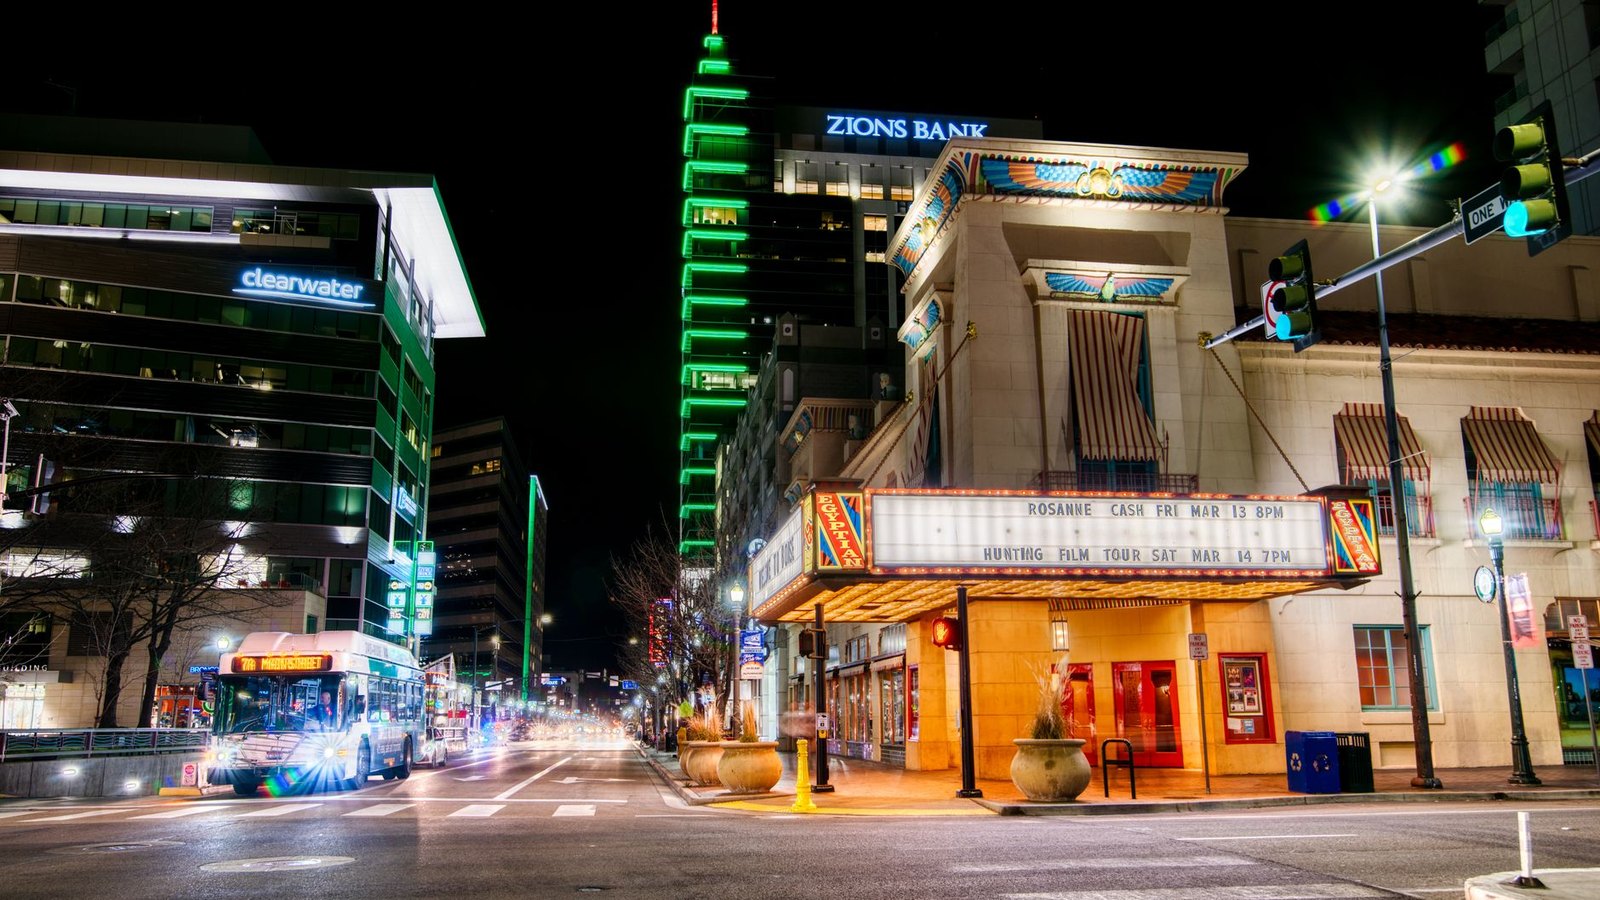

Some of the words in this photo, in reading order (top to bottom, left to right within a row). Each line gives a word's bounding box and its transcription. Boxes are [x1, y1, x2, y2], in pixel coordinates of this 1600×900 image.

[827, 115, 907, 139] ZIONS
[913, 120, 988, 141] BANK
[1472, 203, 1495, 226] ONE
[241, 267, 363, 300] clearwater
[1028, 502, 1092, 516] ROSANNE
[1111, 503, 1144, 517] CASH
[1156, 504, 1178, 518] FRI
[1191, 504, 1220, 518] MAR
[1232, 504, 1247, 519] 13
[1256, 505, 1284, 519] 8PM
[819, 495, 862, 567] EGYPTIAN
[1331, 501, 1377, 571] EGYPTIAN
[983, 547, 1044, 562] HUNTING
[1059, 548, 1090, 562] FILM
[1103, 548, 1141, 562] TOUR
[1152, 549, 1177, 563] SAT
[1192, 549, 1221, 563] MAR
[1237, 550, 1252, 564] 14
[1262, 550, 1291, 564] 7PM
[0, 664, 48, 672] UILDING
